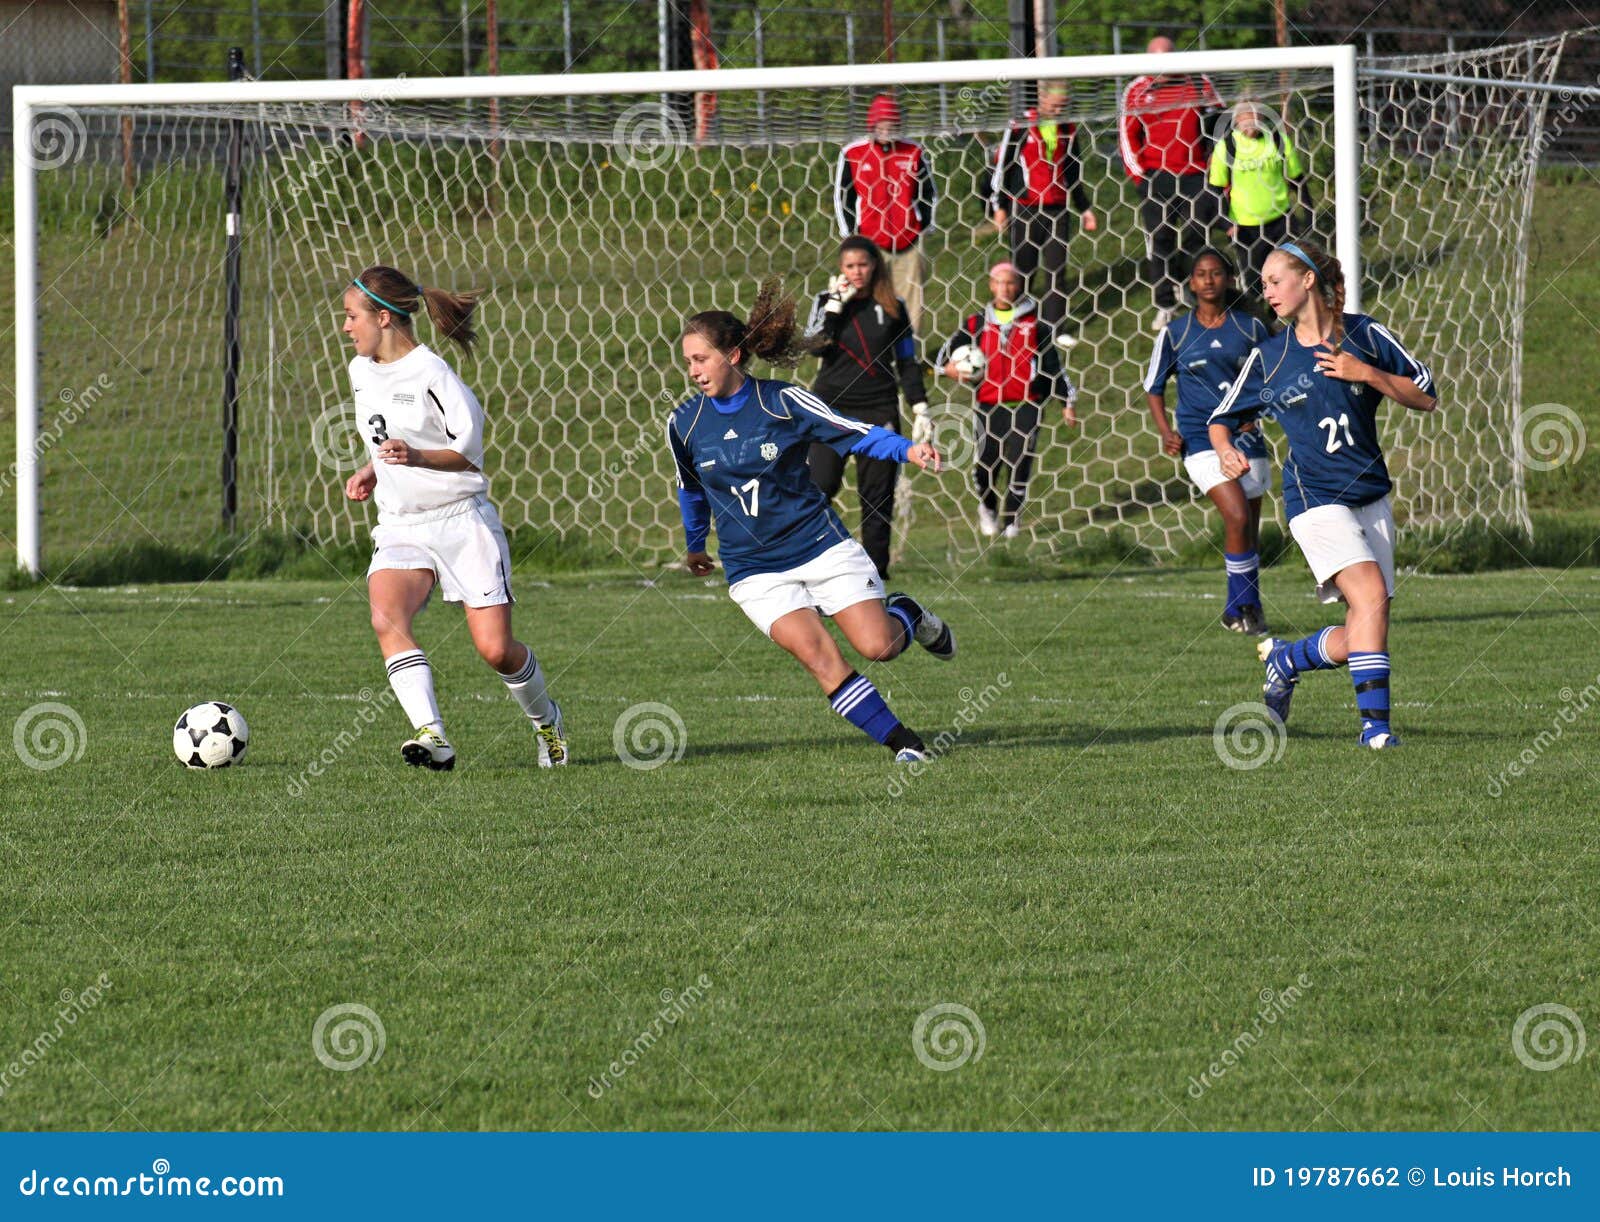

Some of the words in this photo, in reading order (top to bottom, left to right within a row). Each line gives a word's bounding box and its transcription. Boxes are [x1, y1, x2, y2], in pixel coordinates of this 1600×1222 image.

[874, 304, 884, 325] 1
[368, 413, 389, 446] 3
[1318, 412, 1354, 454] 21
[730, 478, 760, 517] 17
